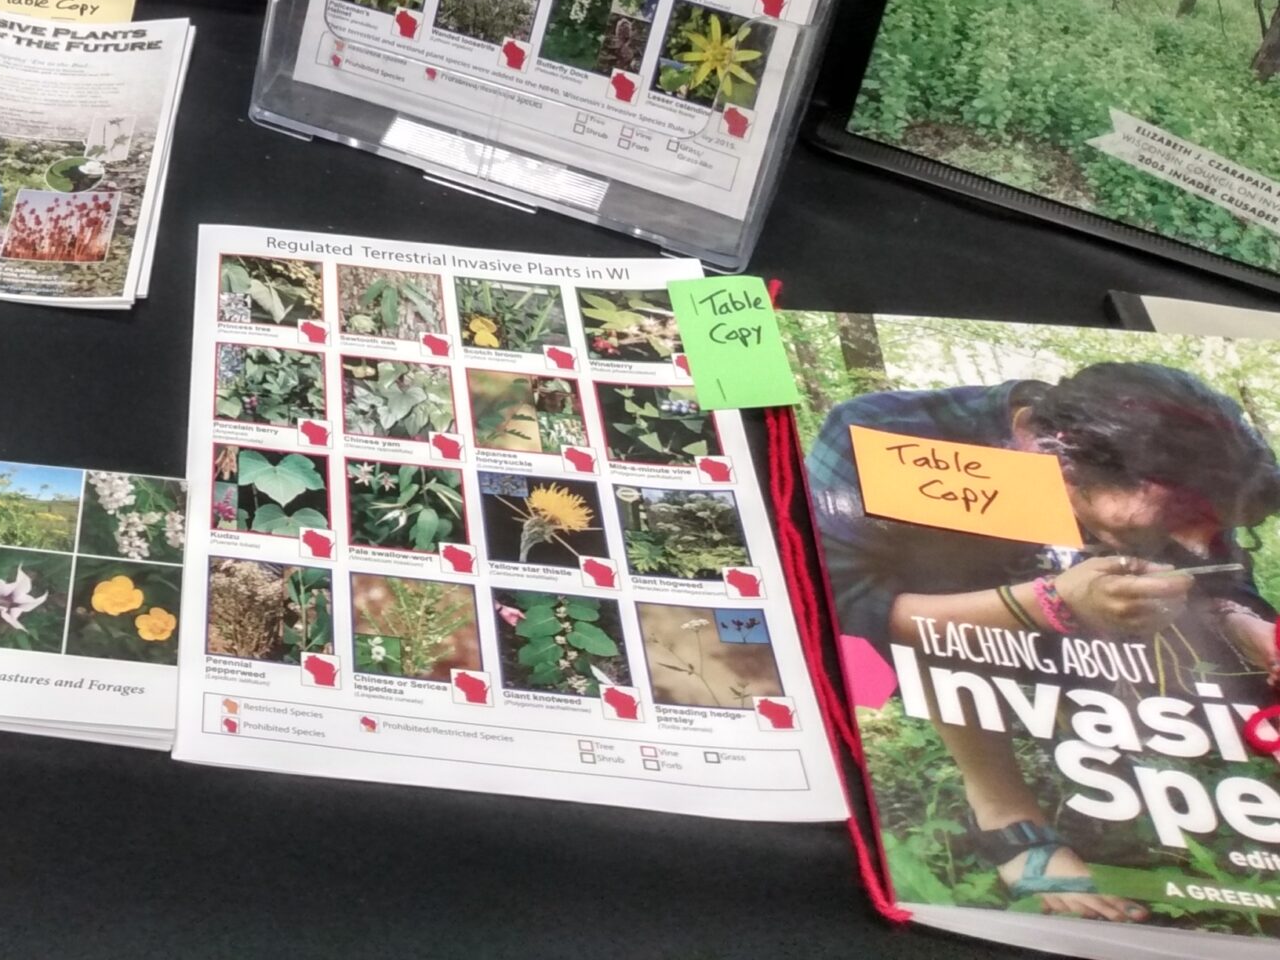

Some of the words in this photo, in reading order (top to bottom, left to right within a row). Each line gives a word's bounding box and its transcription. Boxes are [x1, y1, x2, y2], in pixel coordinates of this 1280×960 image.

[1136, 126, 1193, 157] ELIZABETH
[1209, 160, 1272, 193] CZARAPATA
[1138, 155, 1165, 171] 2005
[1169, 169, 1217, 196] INVADER
[1221, 194, 1280, 224] CRUSADER
[266, 237, 353, 256] Regulated
[362, 247, 447, 266] Terrestrial
[452, 255, 522, 273] Invasive
[528, 263, 581, 277] Plants
[586, 268, 602, 278] in
[606, 267, 630, 280] WI
[699, 290, 766, 316] Table
[885, 443, 991, 478] Table
[210, 531, 240, 541] Kudzu
[911, 615, 1057, 676] TEACHING
[1062, 636, 1158, 685] ABOUT
[54, 675, 85, 689] and
[87, 678, 145, 696] Forages
[1188, 883, 1270, 909] GREEN
